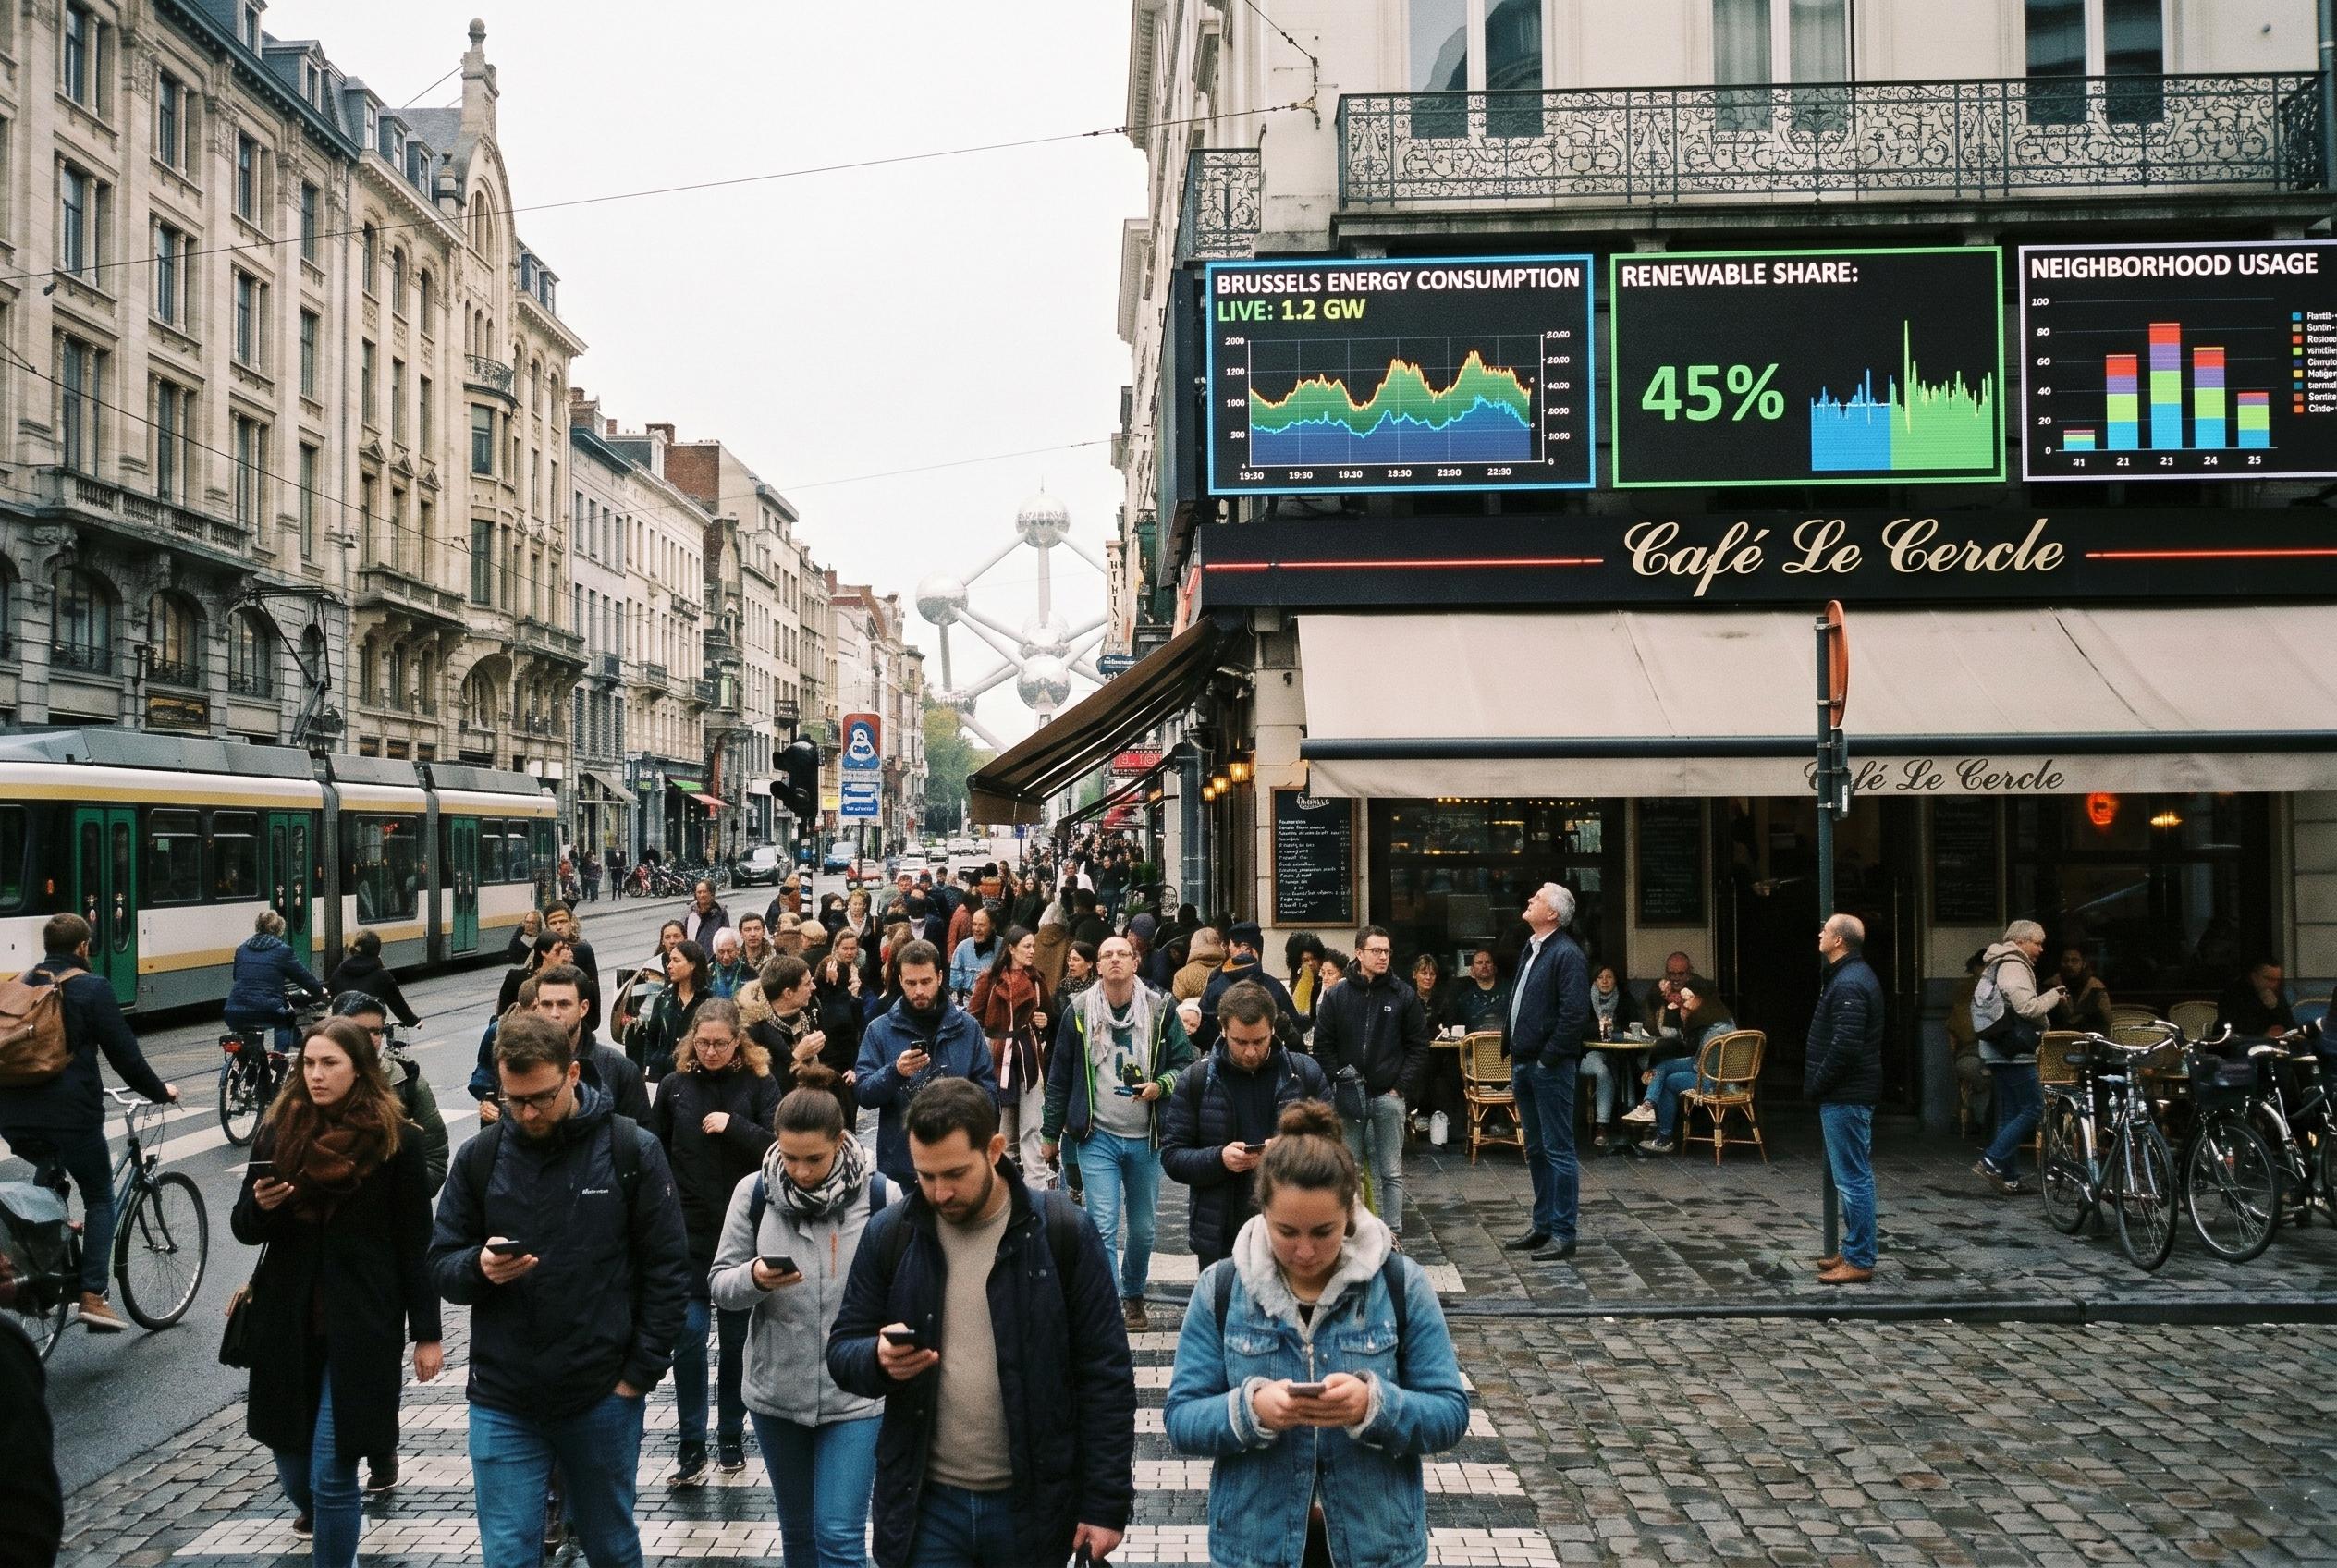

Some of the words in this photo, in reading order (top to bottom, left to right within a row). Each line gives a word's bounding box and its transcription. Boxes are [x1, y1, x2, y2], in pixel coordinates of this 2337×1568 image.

[2031, 254, 2232, 279] NEIGHBORHOOD
[2238, 252, 2319, 276] USAGE
[1621, 263, 1767, 288] RENEWABLE
[1773, 262, 1858, 285] SHARE:
[1217, 272, 1322, 295] BRUSSELS
[1328, 269, 1412, 292] ENERGY
[1415, 267, 1580, 290] CONSUMPTION
[2031, 297, 2049, 307] 100
[1217, 300, 1274, 322] LIVE:
[1281, 299, 1316, 321] 1.2
[1323, 298, 1366, 320] GW
[2036, 327, 2050, 337] 80
[1224, 337, 1245, 346] 2000
[2037, 357, 2051, 366] 60
[1226, 367, 1245, 376] 1200
[1642, 361, 1784, 422] 45%
[2037, 386, 2052, 396] 40
[1226, 398, 1245, 408] 1000
[2037, 416, 2052, 425] 20
[2116, 457, 2130, 467] 21
[2160, 456, 2173, 466] 23
[2203, 456, 2219, 466] 24
[2247, 455, 2262, 465] 25
[1239, 472, 1265, 481] 19:30
[1289, 471, 1314, 480] 19:30
[1623, 521, 1771, 598] Café
[1781, 519, 1863, 574] Le
[1881, 518, 2066, 573] Cercle
[1803, 760, 1889, 795] Cfé
[1895, 758, 1945, 791] Le
[1955, 758, 2065, 791] Cercle
